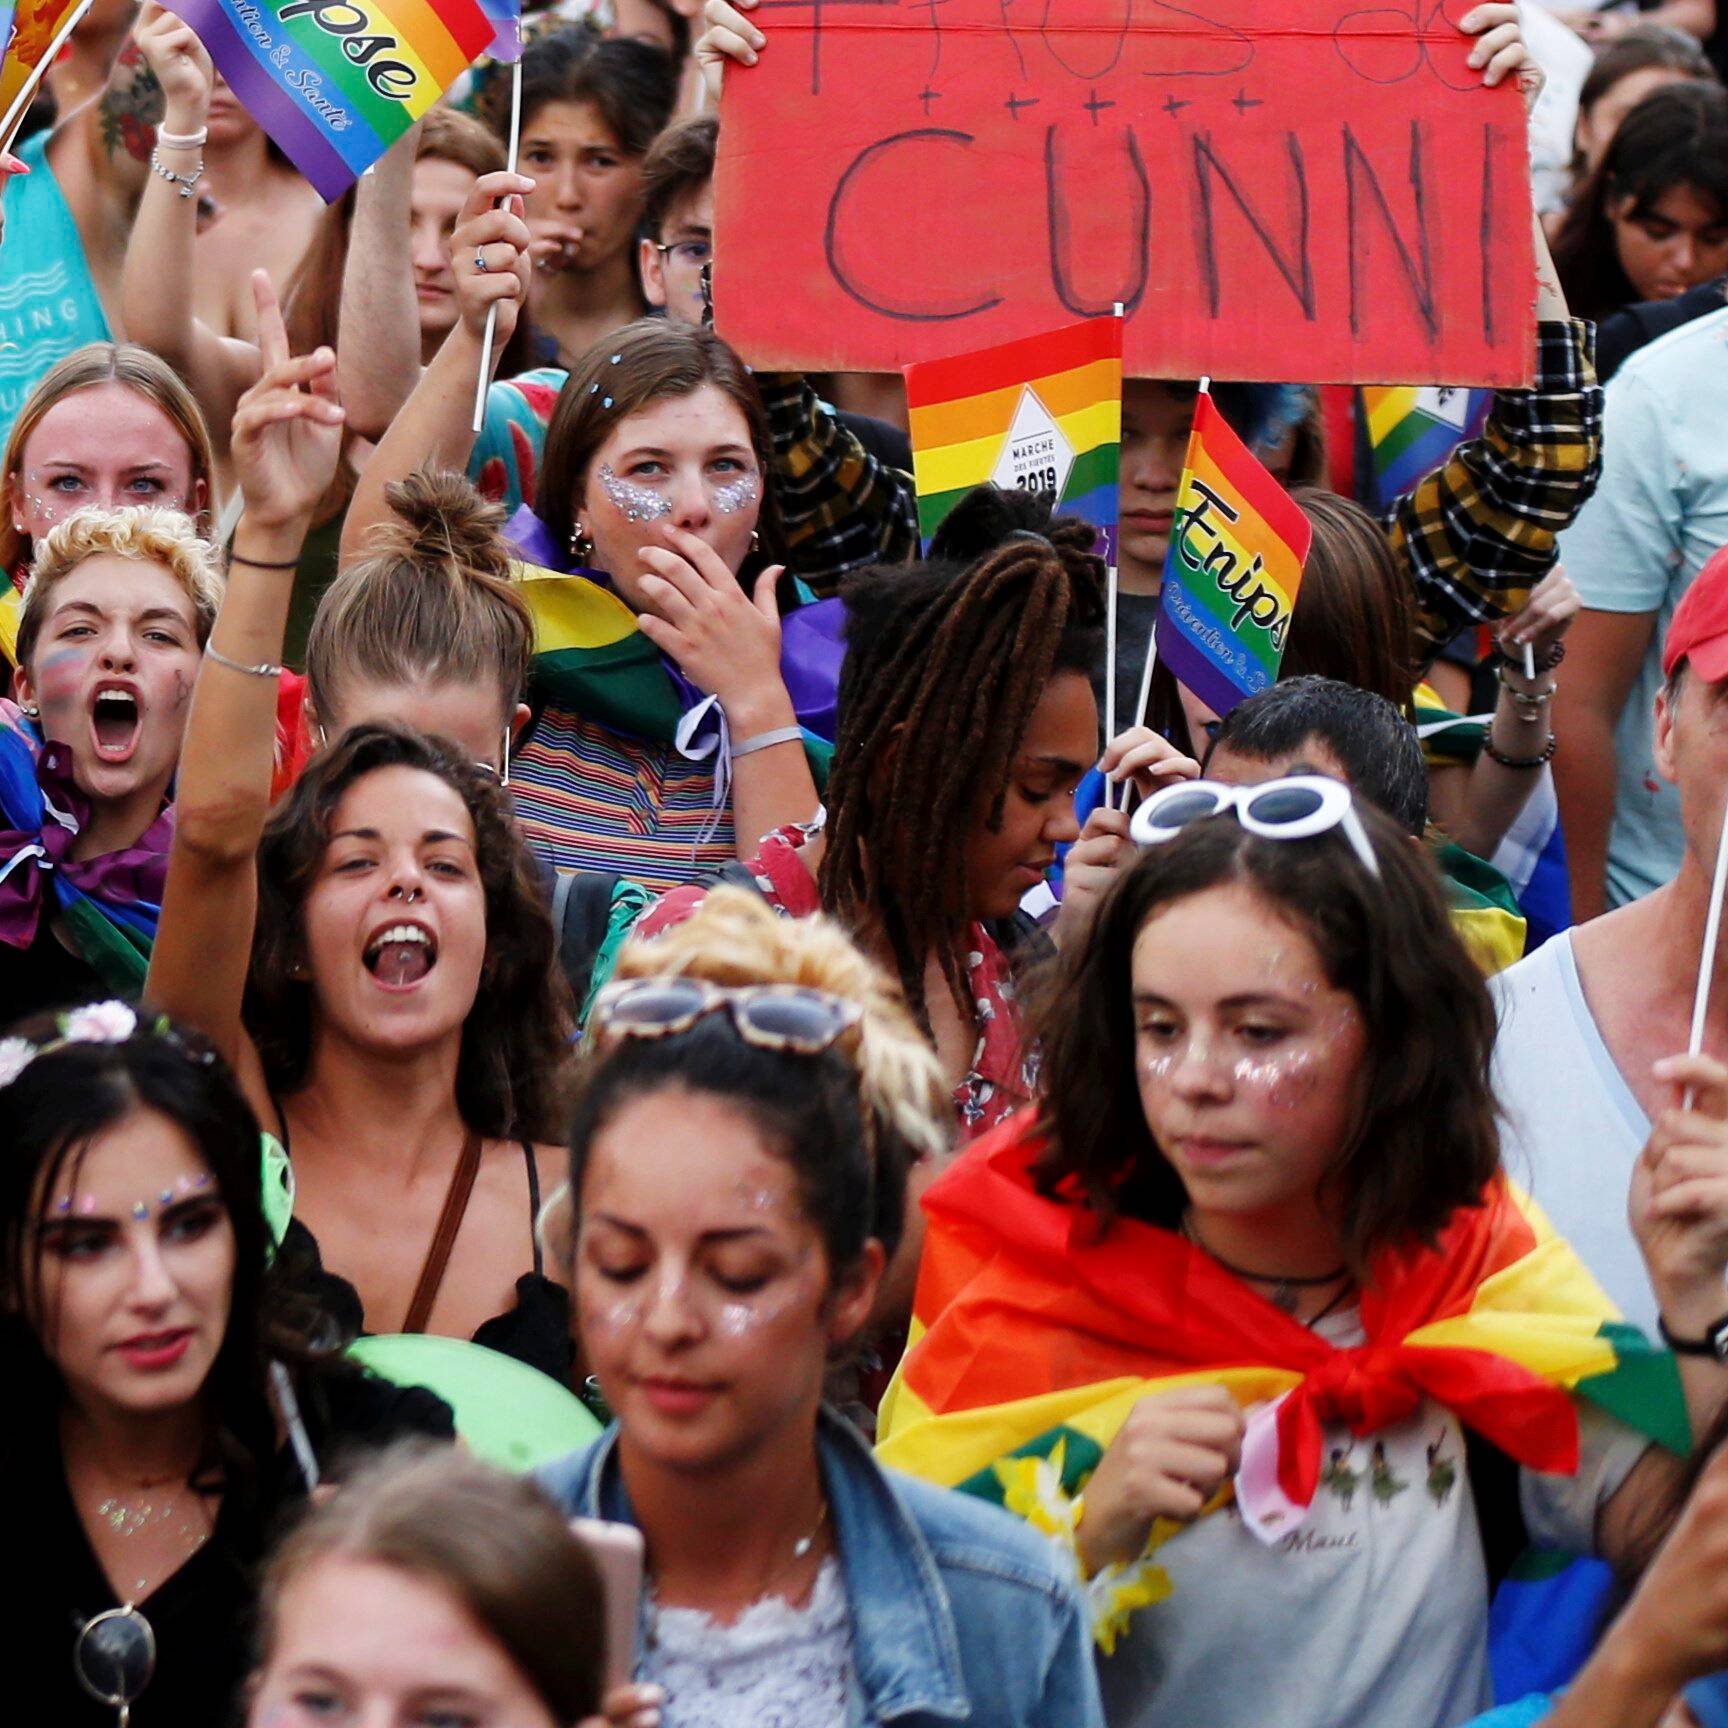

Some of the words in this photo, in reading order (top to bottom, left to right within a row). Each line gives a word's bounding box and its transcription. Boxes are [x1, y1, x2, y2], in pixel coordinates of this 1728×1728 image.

[269, 44, 291, 71] &
[284, 69, 352, 131] Santé
[822, 120, 1501, 350] CUNNI
[1012, 438, 1055, 460] MARCHE
[1178, 478, 1287, 652] Enips
